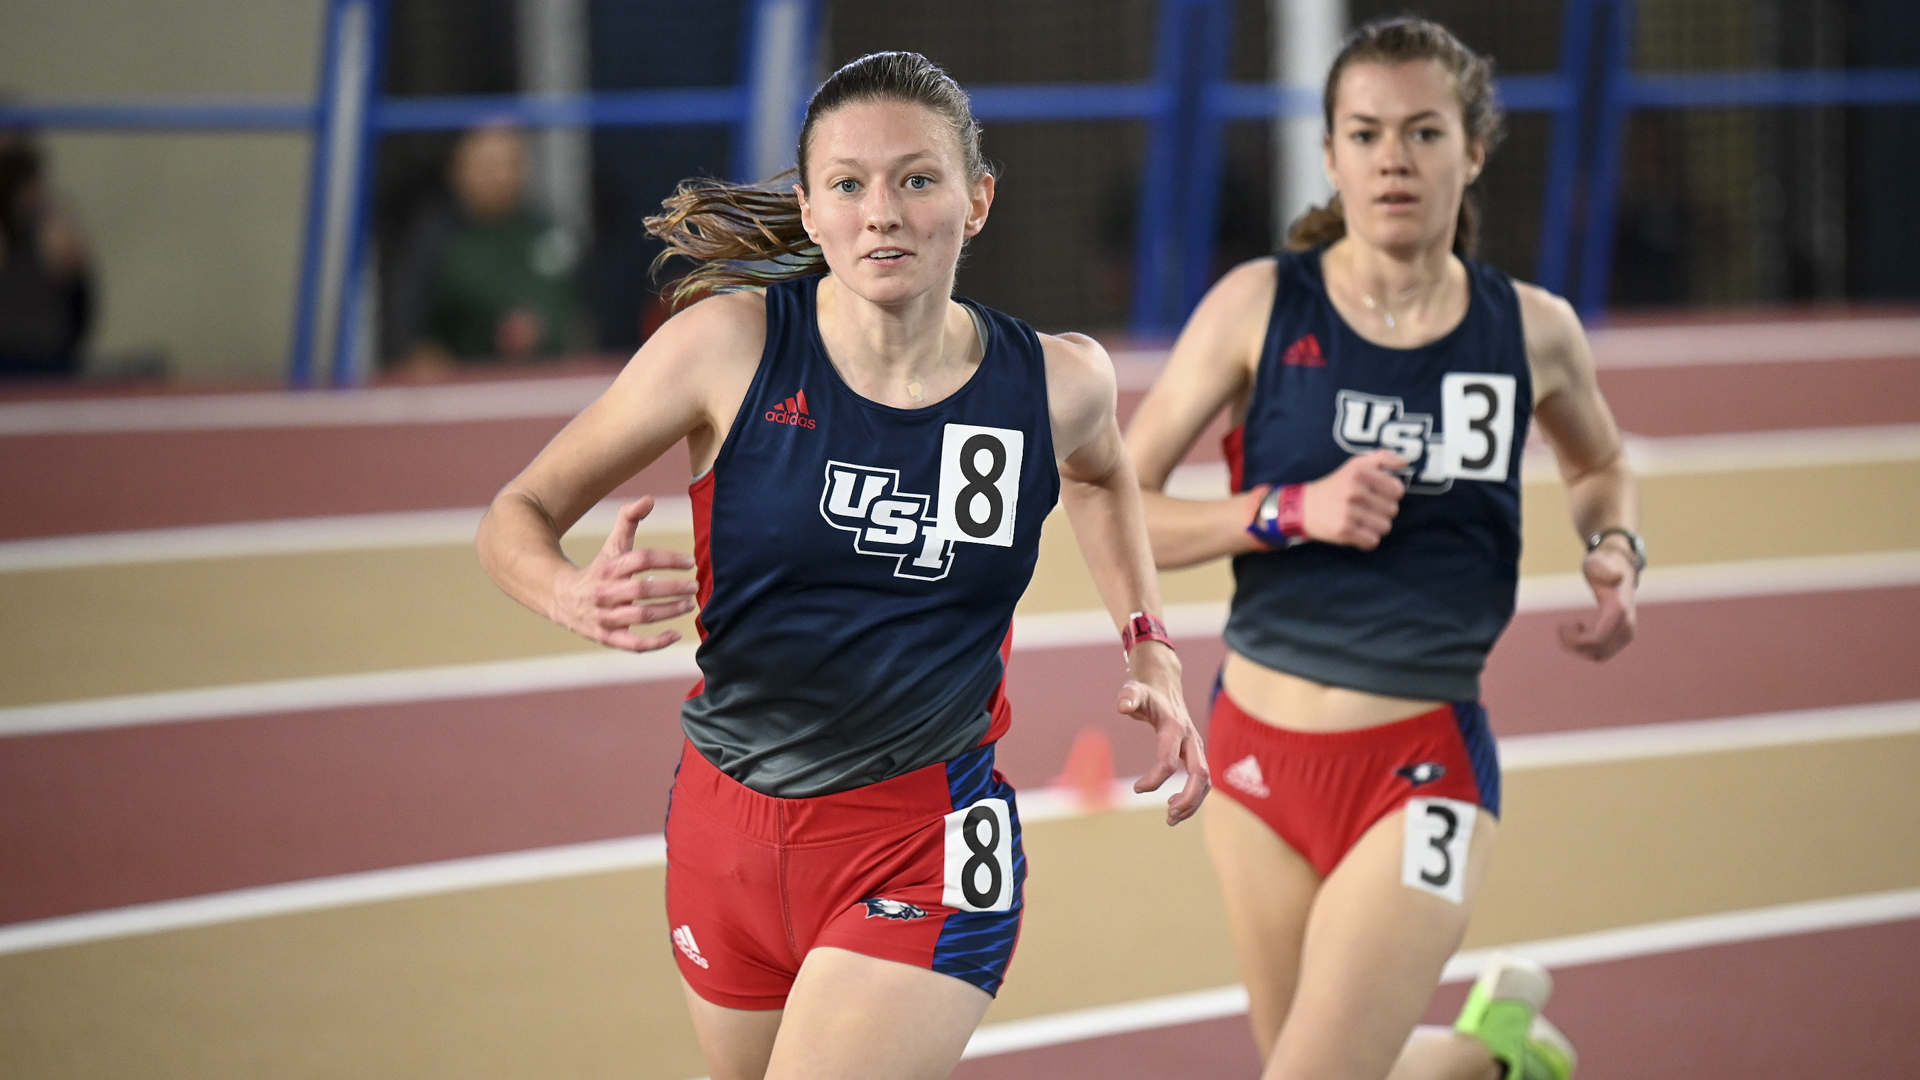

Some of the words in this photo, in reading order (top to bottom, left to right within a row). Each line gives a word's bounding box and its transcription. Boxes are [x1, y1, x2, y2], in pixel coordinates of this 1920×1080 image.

[765, 410, 816, 429] adidas
[1335, 392, 1452, 491] USI
[1461, 383, 1498, 470] 3
[821, 462, 952, 579] USI
[954, 433, 1007, 539] 8
[961, 805, 1000, 909] 8
[1420, 805, 1458, 887] 3
